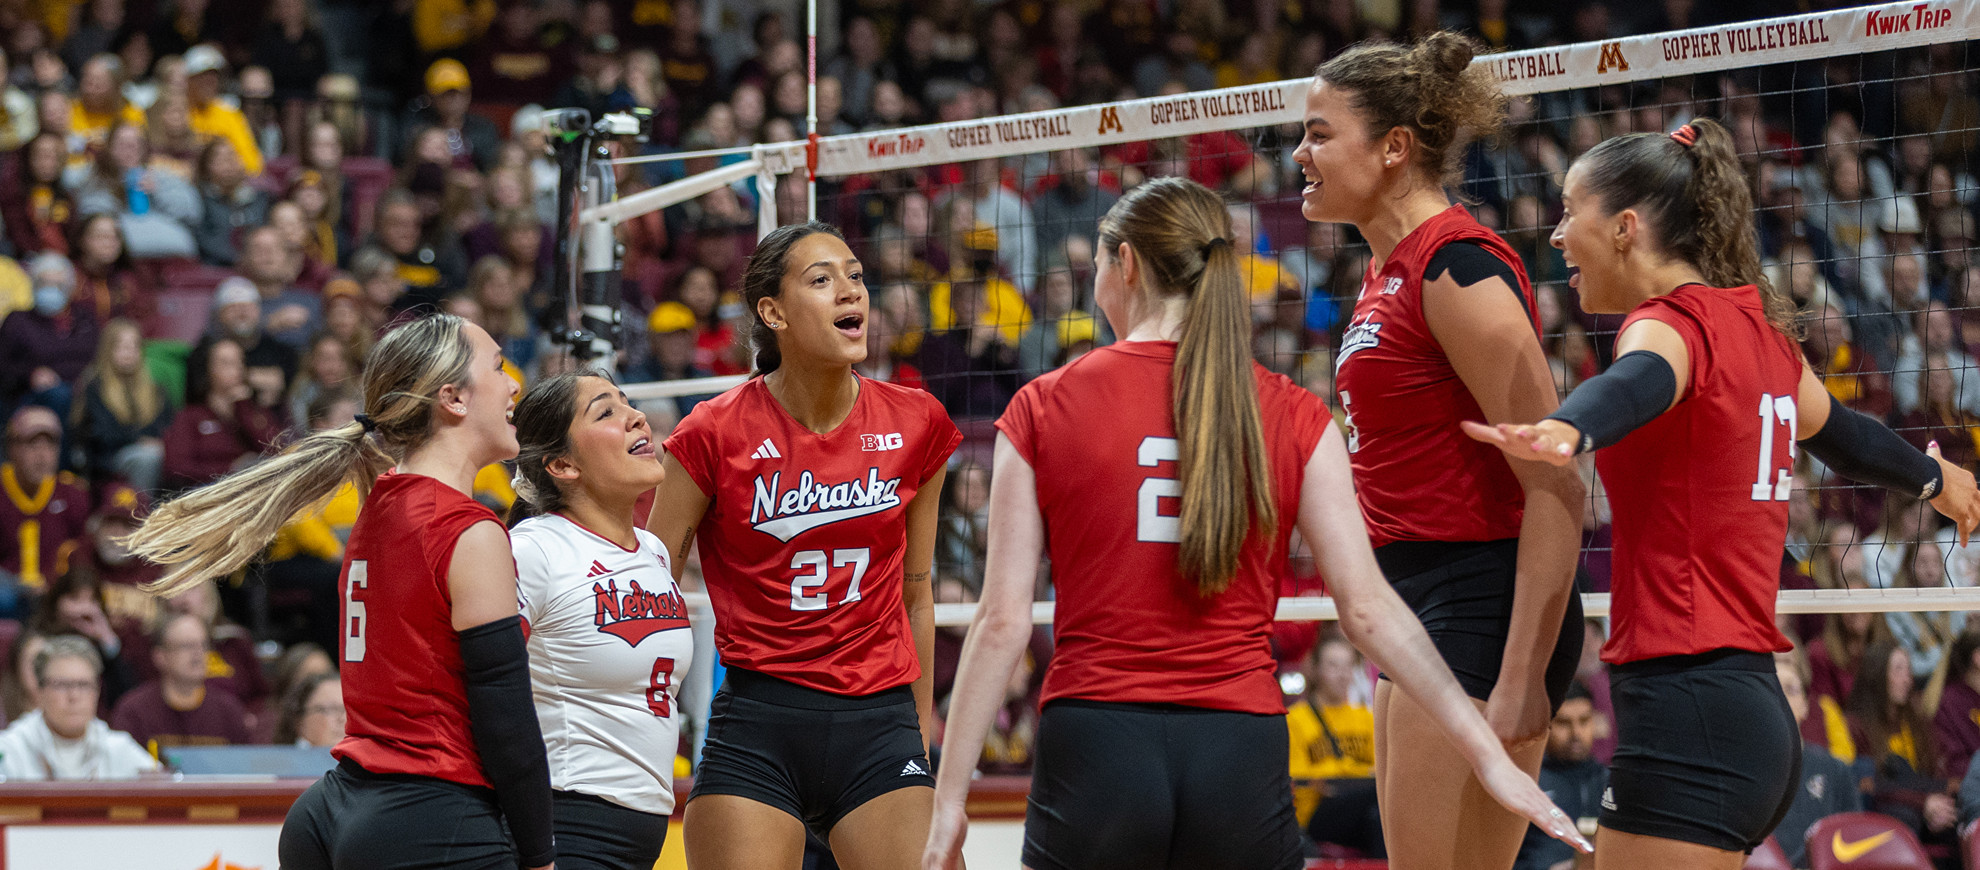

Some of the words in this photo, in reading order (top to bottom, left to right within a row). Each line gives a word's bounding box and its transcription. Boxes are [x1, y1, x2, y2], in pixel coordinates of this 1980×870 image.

[1597, 42, 1629, 74] M
[1662, 32, 1722, 61] GOPHER
[1726, 18, 1829, 54] VOLLEYBALL
[947, 124, 993, 149] GOPHER
[996, 114, 1072, 143] VOLLEYBALL
[1098, 105, 1124, 134] M
[1151, 97, 1199, 125] GOPHER
[1201, 88, 1285, 119] VOLLEYBALL
[1751, 392, 1797, 502] 13
[750, 466, 902, 524] Nebraska
[1137, 435, 1184, 543] 2
[790, 547, 871, 612] 27
[345, 559, 368, 662] 6
[645, 656, 675, 719] 8
